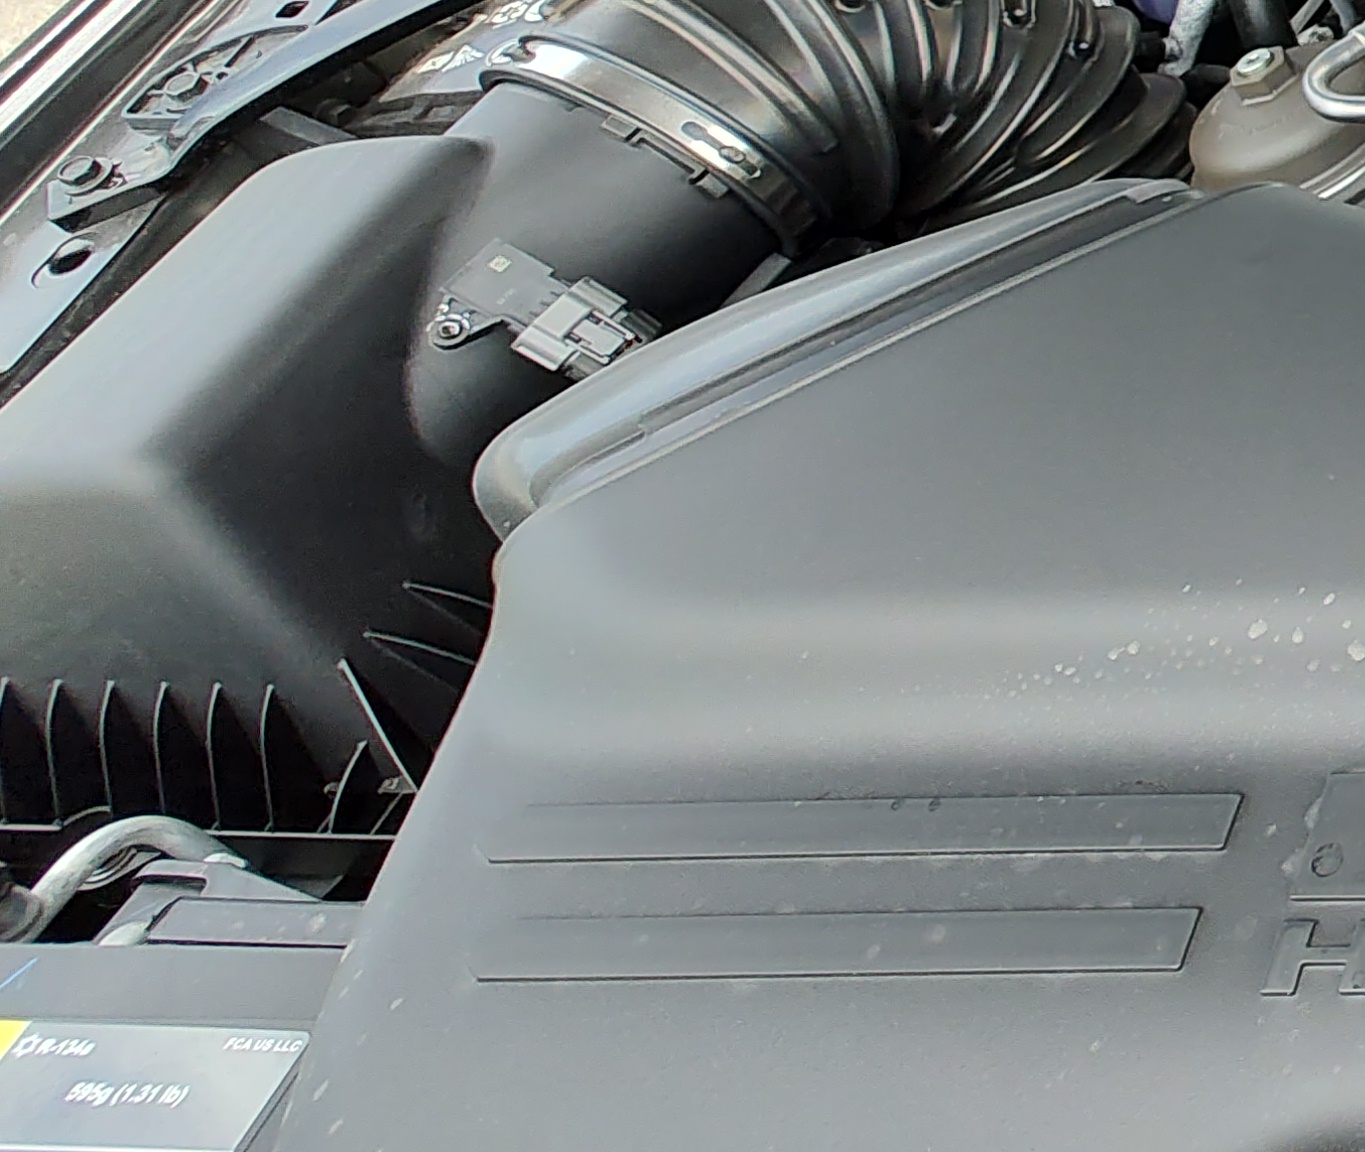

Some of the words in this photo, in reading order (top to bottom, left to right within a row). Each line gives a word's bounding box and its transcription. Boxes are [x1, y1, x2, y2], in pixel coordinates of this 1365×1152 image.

[222, 1036, 252, 1051] FCA
[252, 1037, 274, 1051] US
[272, 1038, 303, 1053] LLC
[109, 1082, 158, 1107] (1.31
[157, 1084, 191, 1109] lb)
